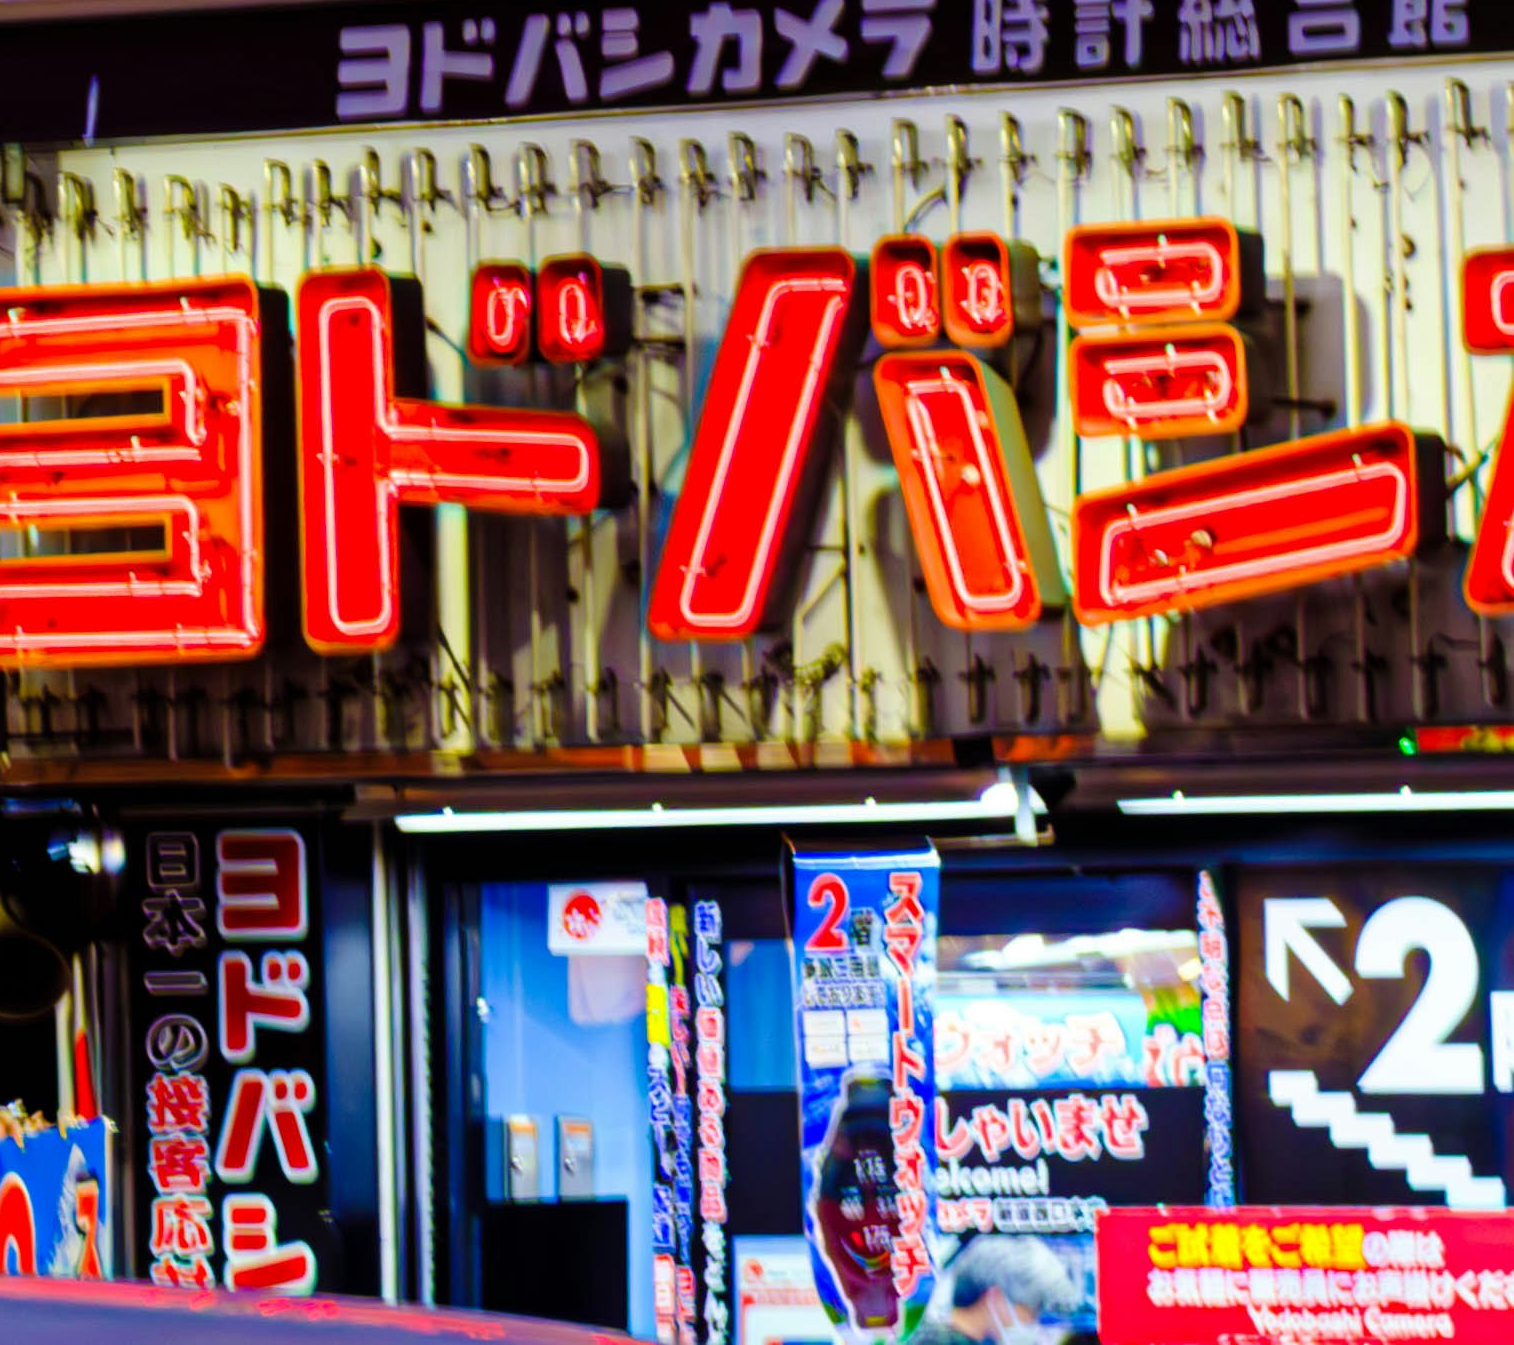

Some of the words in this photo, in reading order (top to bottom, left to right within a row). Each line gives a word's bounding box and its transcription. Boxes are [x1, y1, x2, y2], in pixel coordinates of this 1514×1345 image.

[215, 829, 317, 1296] ヨドバシ
[884, 872, 932, 1298] スマートウォッチ
[934, 1092, 1148, 1162] しゃいませ
[935, 1158, 1049, 1196] elcome!
